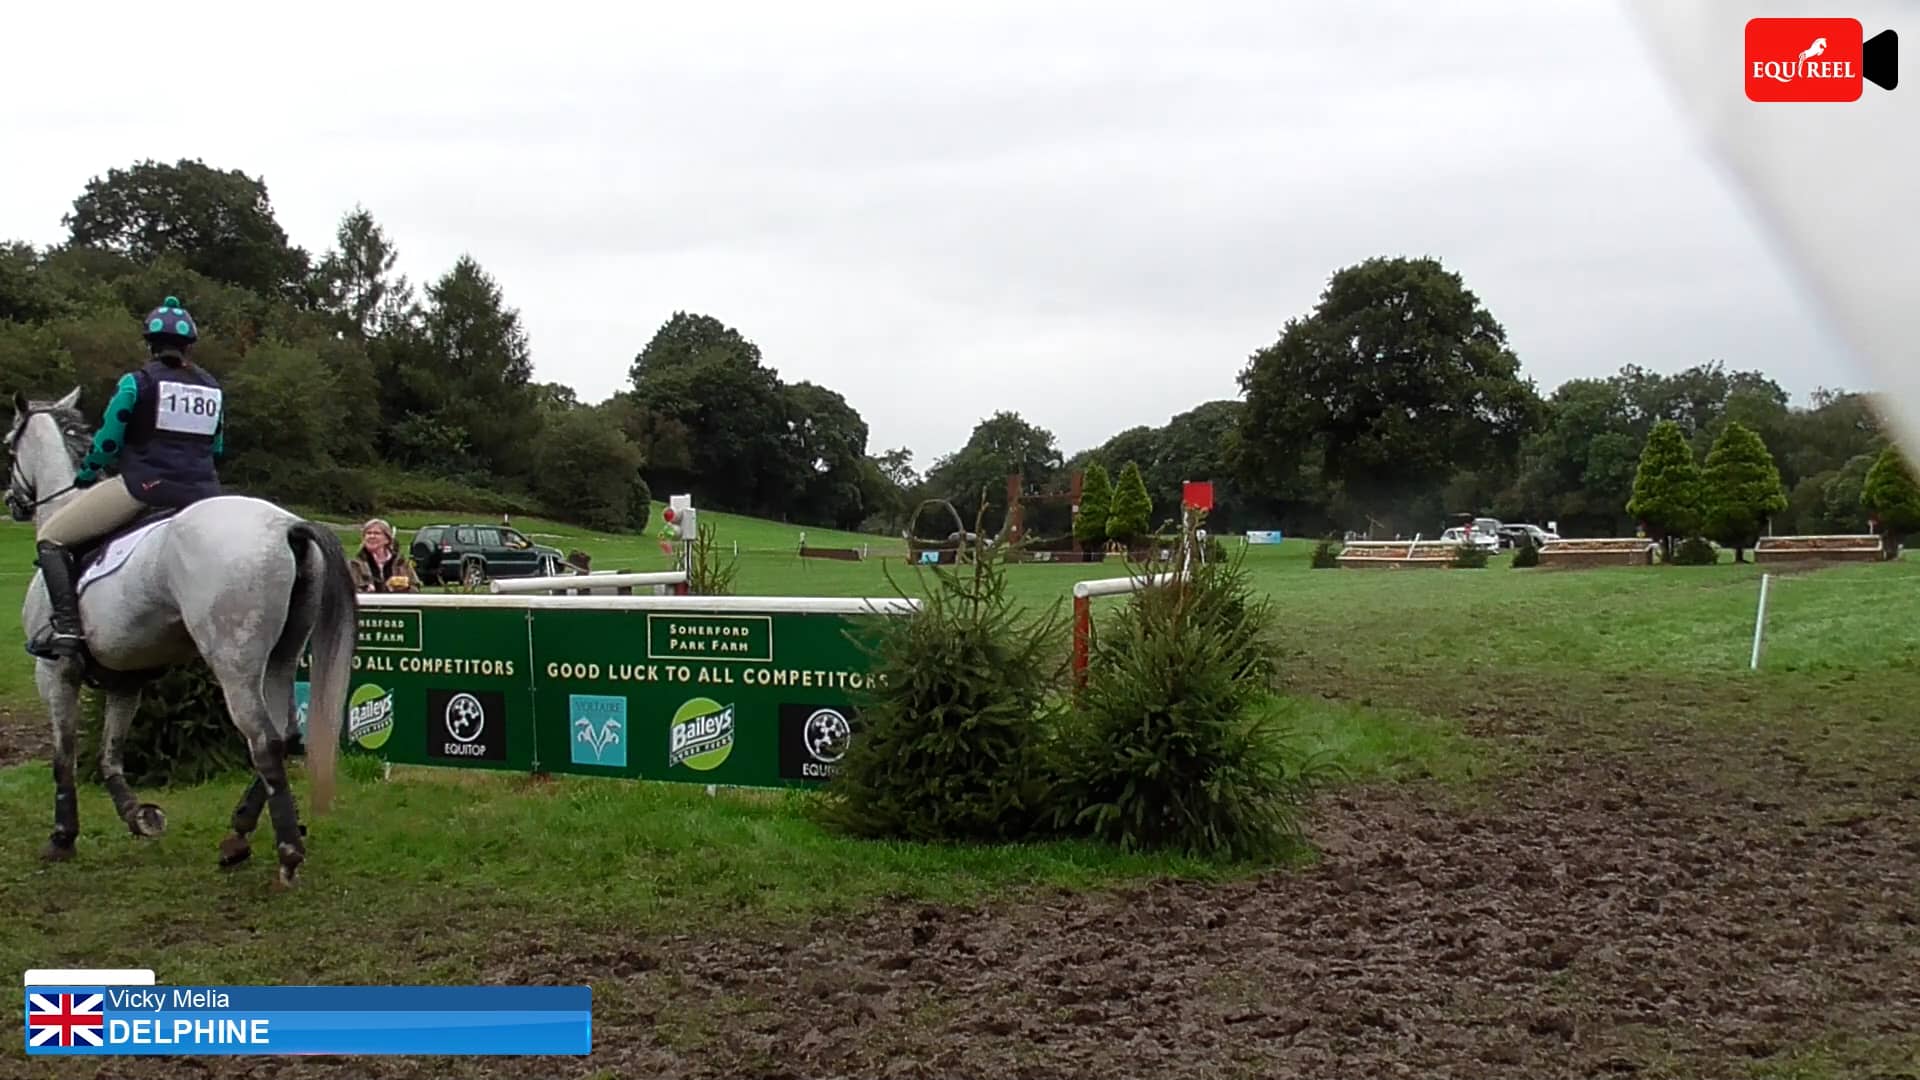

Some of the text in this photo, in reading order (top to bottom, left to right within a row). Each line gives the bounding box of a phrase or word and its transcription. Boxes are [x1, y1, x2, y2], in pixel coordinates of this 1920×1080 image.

[168, 394, 216, 416] 1180
[376, 631, 404, 642] FARM
[670, 623, 749, 636] SOMERFORD
[670, 638, 748, 652] PARK FARM
[366, 656, 394, 671] ALL
[400, 657, 514, 676] COMPETITORS
[547, 662, 889, 689] GOOD LUCK TO ALL COMPETITORS
[350, 693, 393, 731] Baileys
[671, 708, 732, 753] Baileys
[444, 743, 486, 756] EQUITOP
